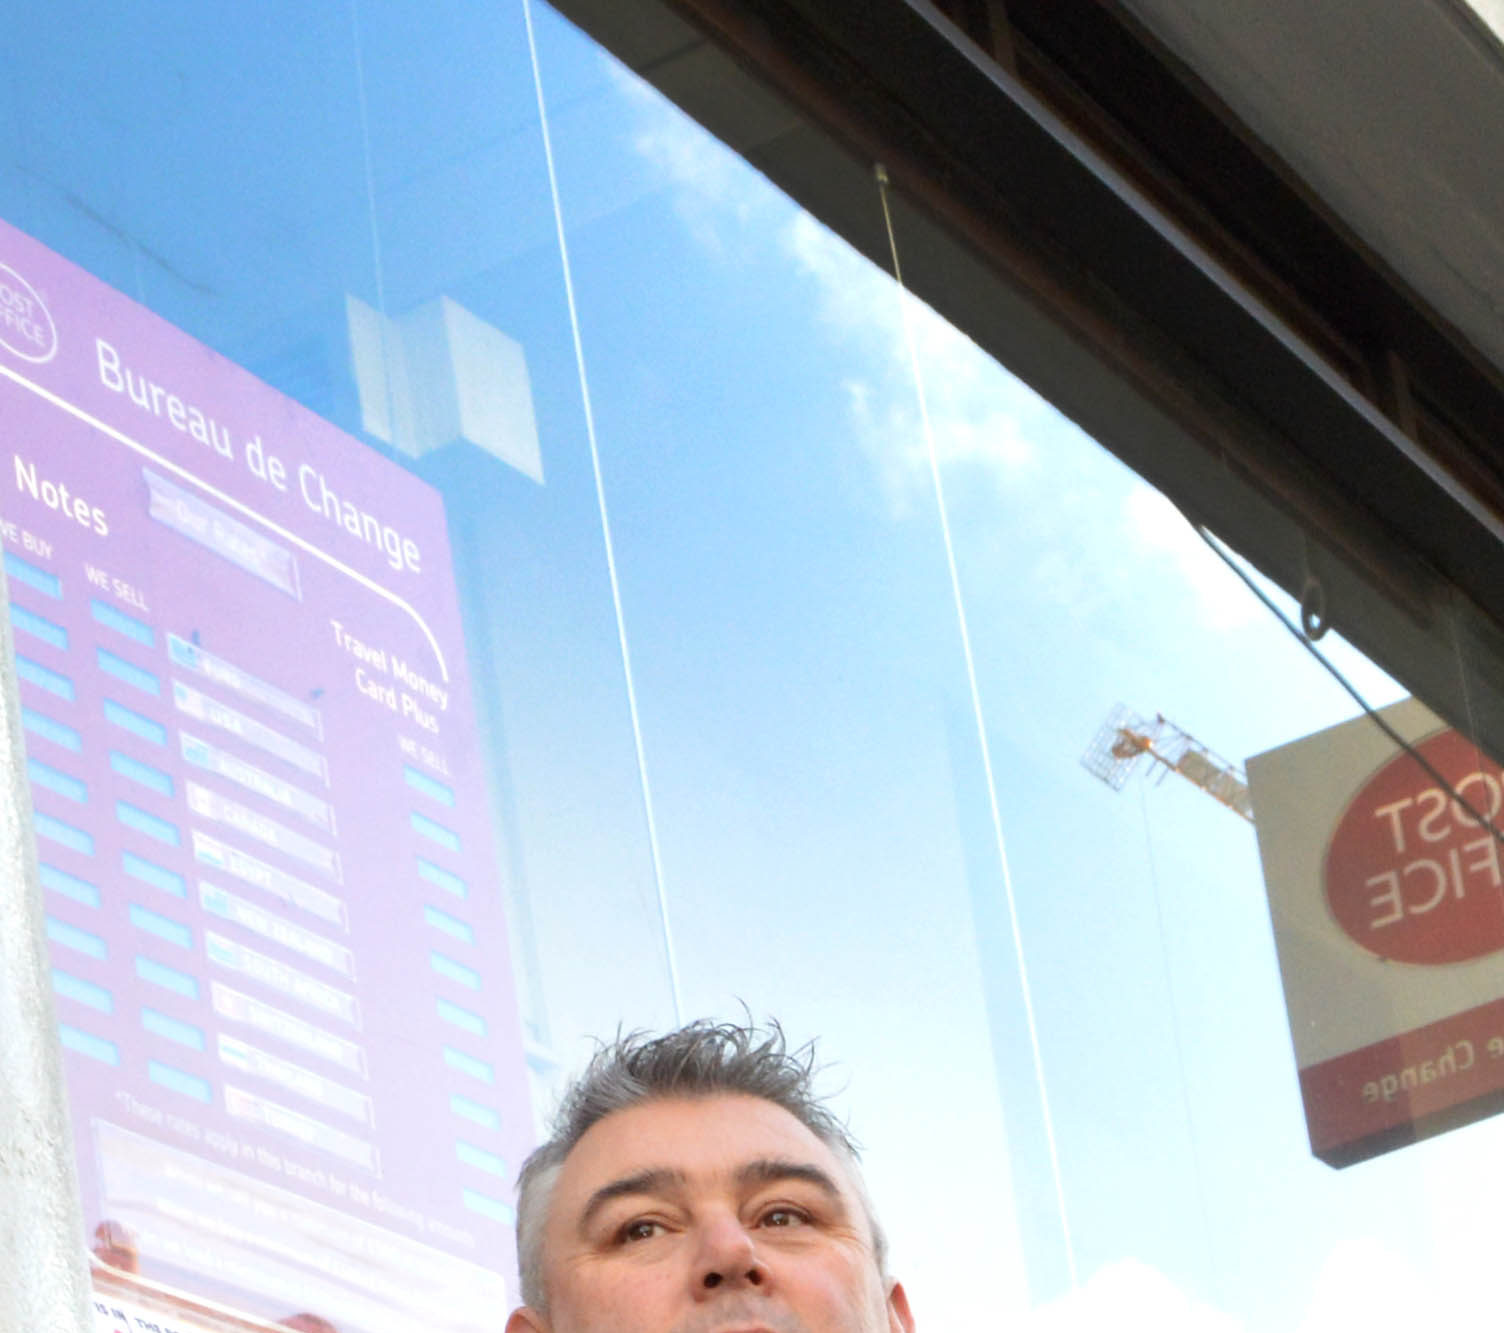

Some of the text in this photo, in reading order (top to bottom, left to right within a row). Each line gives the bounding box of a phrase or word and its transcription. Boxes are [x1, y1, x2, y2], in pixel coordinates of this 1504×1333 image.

[96, 337, 422, 575] Bureau de Change
[13, 455, 109, 537] Notes
[22, 532, 54, 560] BUY
[84, 562, 149, 613] WE SELL
[330, 619, 448, 711] Travel Money
[356, 667, 439, 733] Card Plus
